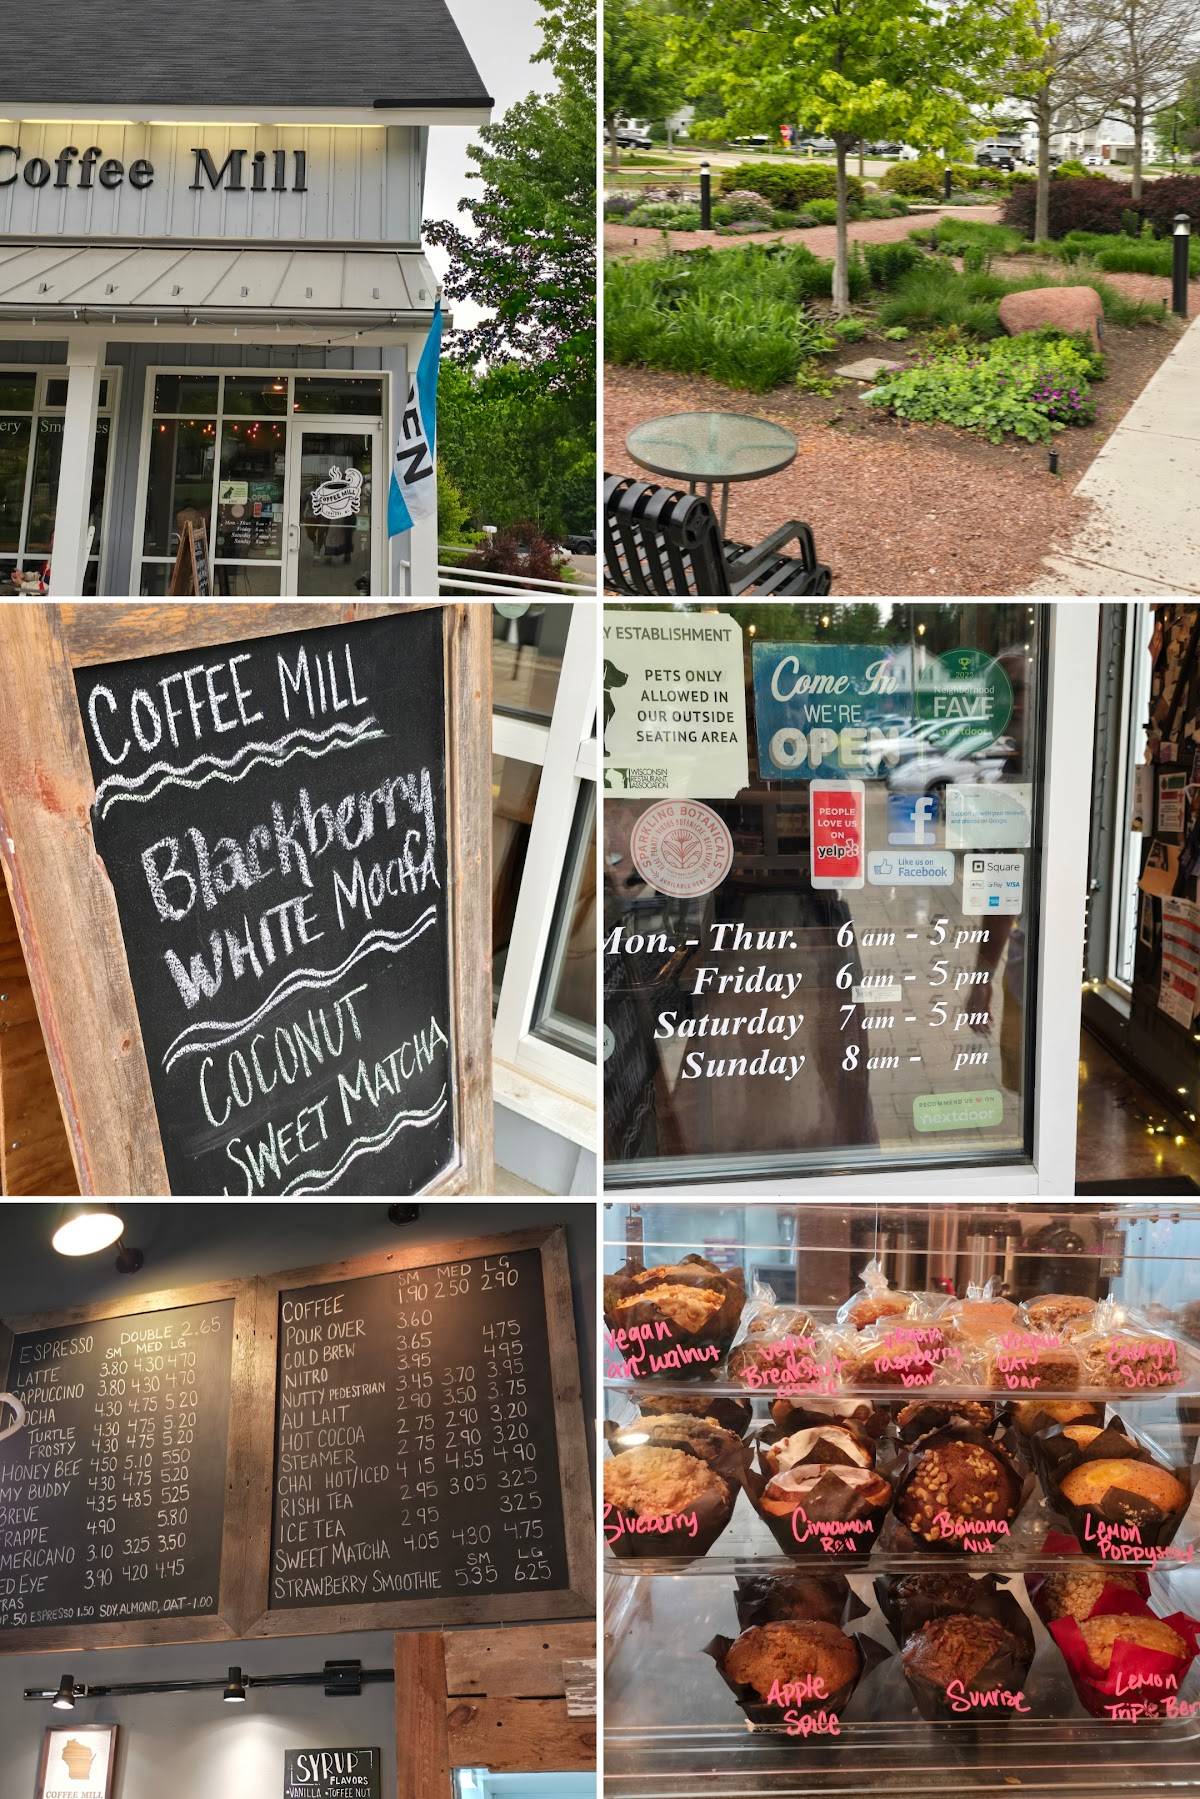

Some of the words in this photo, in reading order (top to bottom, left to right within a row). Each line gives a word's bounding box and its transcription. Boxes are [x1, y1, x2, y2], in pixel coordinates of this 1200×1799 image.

[0, 146, 155, 189] Coffee
[189, 147, 307, 192] Mill
[616, 627, 732, 641] ESTABLISHMENT
[645, 669, 680, 682] PETS
[686, 670, 722, 682] ONLY
[771, 655, 850, 702] Come
[858, 660, 899, 696] In
[641, 690, 709, 702] ALLOWED
[714, 691, 728, 702] IN
[934, 685, 994, 695] Neighborhood
[87, 653, 264, 765] COFFEE
[277, 643, 368, 720] MILL
[637, 710, 667, 722] OUR
[672, 711, 734, 723] OUTSIDE
[804, 704, 862, 723] WE'RE
[933, 697, 994, 719] FAVE
[636, 730, 697, 742] SEATING
[701, 731, 738, 743] AREA
[769, 727, 900, 769] OPEN
[631, 768, 668, 776] WISCONSIN
[817, 819, 842, 828] LOVE
[844, 819, 857, 828] US
[819, 807, 856, 816] PEOPLE
[140, 767, 437, 922] Blackberry
[638, 807, 674, 868] SPARKLING
[680, 807, 725, 868] BOTANICALS
[830, 831, 845, 839] ON
[818, 844, 846, 858] yelp
[898, 858, 914, 866] Like
[898, 867, 948, 877] Facebook
[987, 862, 1020, 872] Square
[163, 893, 325, 1009] WHITE
[334, 854, 441, 929] MOCHA
[604, 926, 676, 954] Mon.
[709, 923, 798, 951] Thur.
[836, 920, 855, 948] 6
[861, 931, 896, 947] am
[929, 918, 949, 946] 5
[954, 930, 990, 949] pm
[690, 965, 803, 1000] Friday
[835, 962, 854, 990] 6
[860, 973, 894, 988] am
[929, 960, 949, 986] 5
[953, 970, 990, 990] pm
[653, 1008, 804, 1041] Saturday
[839, 1004, 857, 1031] 7
[861, 1014, 895, 1030] am
[928, 1001, 949, 1027] 5
[953, 1011, 989, 1031] pm
[199, 983, 368, 1127] COCONUT
[681, 1049, 806, 1081] Sunday
[842, 1044, 860, 1071] 8
[866, 1055, 900, 1070] am
[953, 1051, 989, 1071] pm
[224, 1096, 329, 1196] SWEET
[337, 1016, 449, 1126] MATCHA
[920, 1108, 994, 1124] nextdoor
[398, 1271, 420, 1286] SM
[437, 1264, 472, 1279] MED
[282, 1294, 345, 1323] COFFEE
[19, 1336, 94, 1364] ESPRESSO
[120, 1326, 174, 1345] DOUBLE
[181, 1316, 220, 1336] 2.65
[286, 1325, 323, 1347] POUR
[327, 1319, 366, 1340] OVER
[396, 1309, 433, 1329] 3.60
[105, 1347, 122, 1359] SM
[136, 1342, 163, 1354] MED
[170, 1338, 186, 1349] LG
[284, 1348, 319, 1370] COLD
[323, 1343, 355, 1362] BREW
[396, 1331, 433, 1351] 3.65
[482, 1320, 521, 1340] 4.75
[649, 1344, 720, 1372] walnut
[17, 1367, 61, 1387] LATTE
[99, 1360, 128, 1377] 3.80
[285, 1368, 328, 1389] NITRO
[900, 1370, 935, 1388] bar
[1005, 1374, 1041, 1389] bar
[282, 1387, 325, 1409] NUTTY
[329, 1381, 386, 1401] PEDESTRIAN
[281, 1412, 304, 1431] AU
[312, 1404, 350, 1426] LAIT
[28, 1426, 76, 1444] TURTLE
[281, 1431, 313, 1451] HOT
[318, 1426, 365, 1448] COCOA
[29, 1441, 76, 1460] FROSTY
[282, 1449, 356, 1473] STEAMER
[2, 1462, 51, 1483] HONEY
[55, 1458, 83, 1478] BEE
[278, 1475, 312, 1496] CHAI
[325, 1464, 390, 1488] HOT/ICED
[28, 1481, 71, 1500] BUDDY
[280, 1496, 320, 1518] RISHI
[327, 1492, 353, 1511] TEA
[280, 1521, 308, 1543] ICE
[314, 1519, 346, 1539] TEA
[604, 1503, 698, 1544] Blueberry
[791, 1505, 874, 1543] Cinnamon
[932, 1512, 1011, 1537] Banana
[1084, 1513, 1142, 1544] Lemon
[275, 1545, 328, 1573] SWEET
[332, 1539, 391, 1565] MATCHA
[963, 1538, 995, 1553] Nut
[19, 1573, 49, 1594] EYE
[274, 1575, 368, 1599] STRAWBERRY
[372, 1569, 442, 1593] SMOOTHIE
[767, 1674, 829, 1707] Apple
[946, 1678, 1032, 1713] Sunrise
[1115, 1672, 1178, 1696] Lemon
[784, 1709, 840, 1737] Spice
[296, 1752, 359, 1782] SYRUP
[289, 1786, 322, 1798] VANILLA
[327, 1787, 353, 1797] TOFFEE
[355, 1787, 371, 1797] NUT
[330, 1776, 369, 1785] FLAVORS
[46, 1791, 79, 1799] COFFEE
[80, 1791, 103, 1799] MILL
